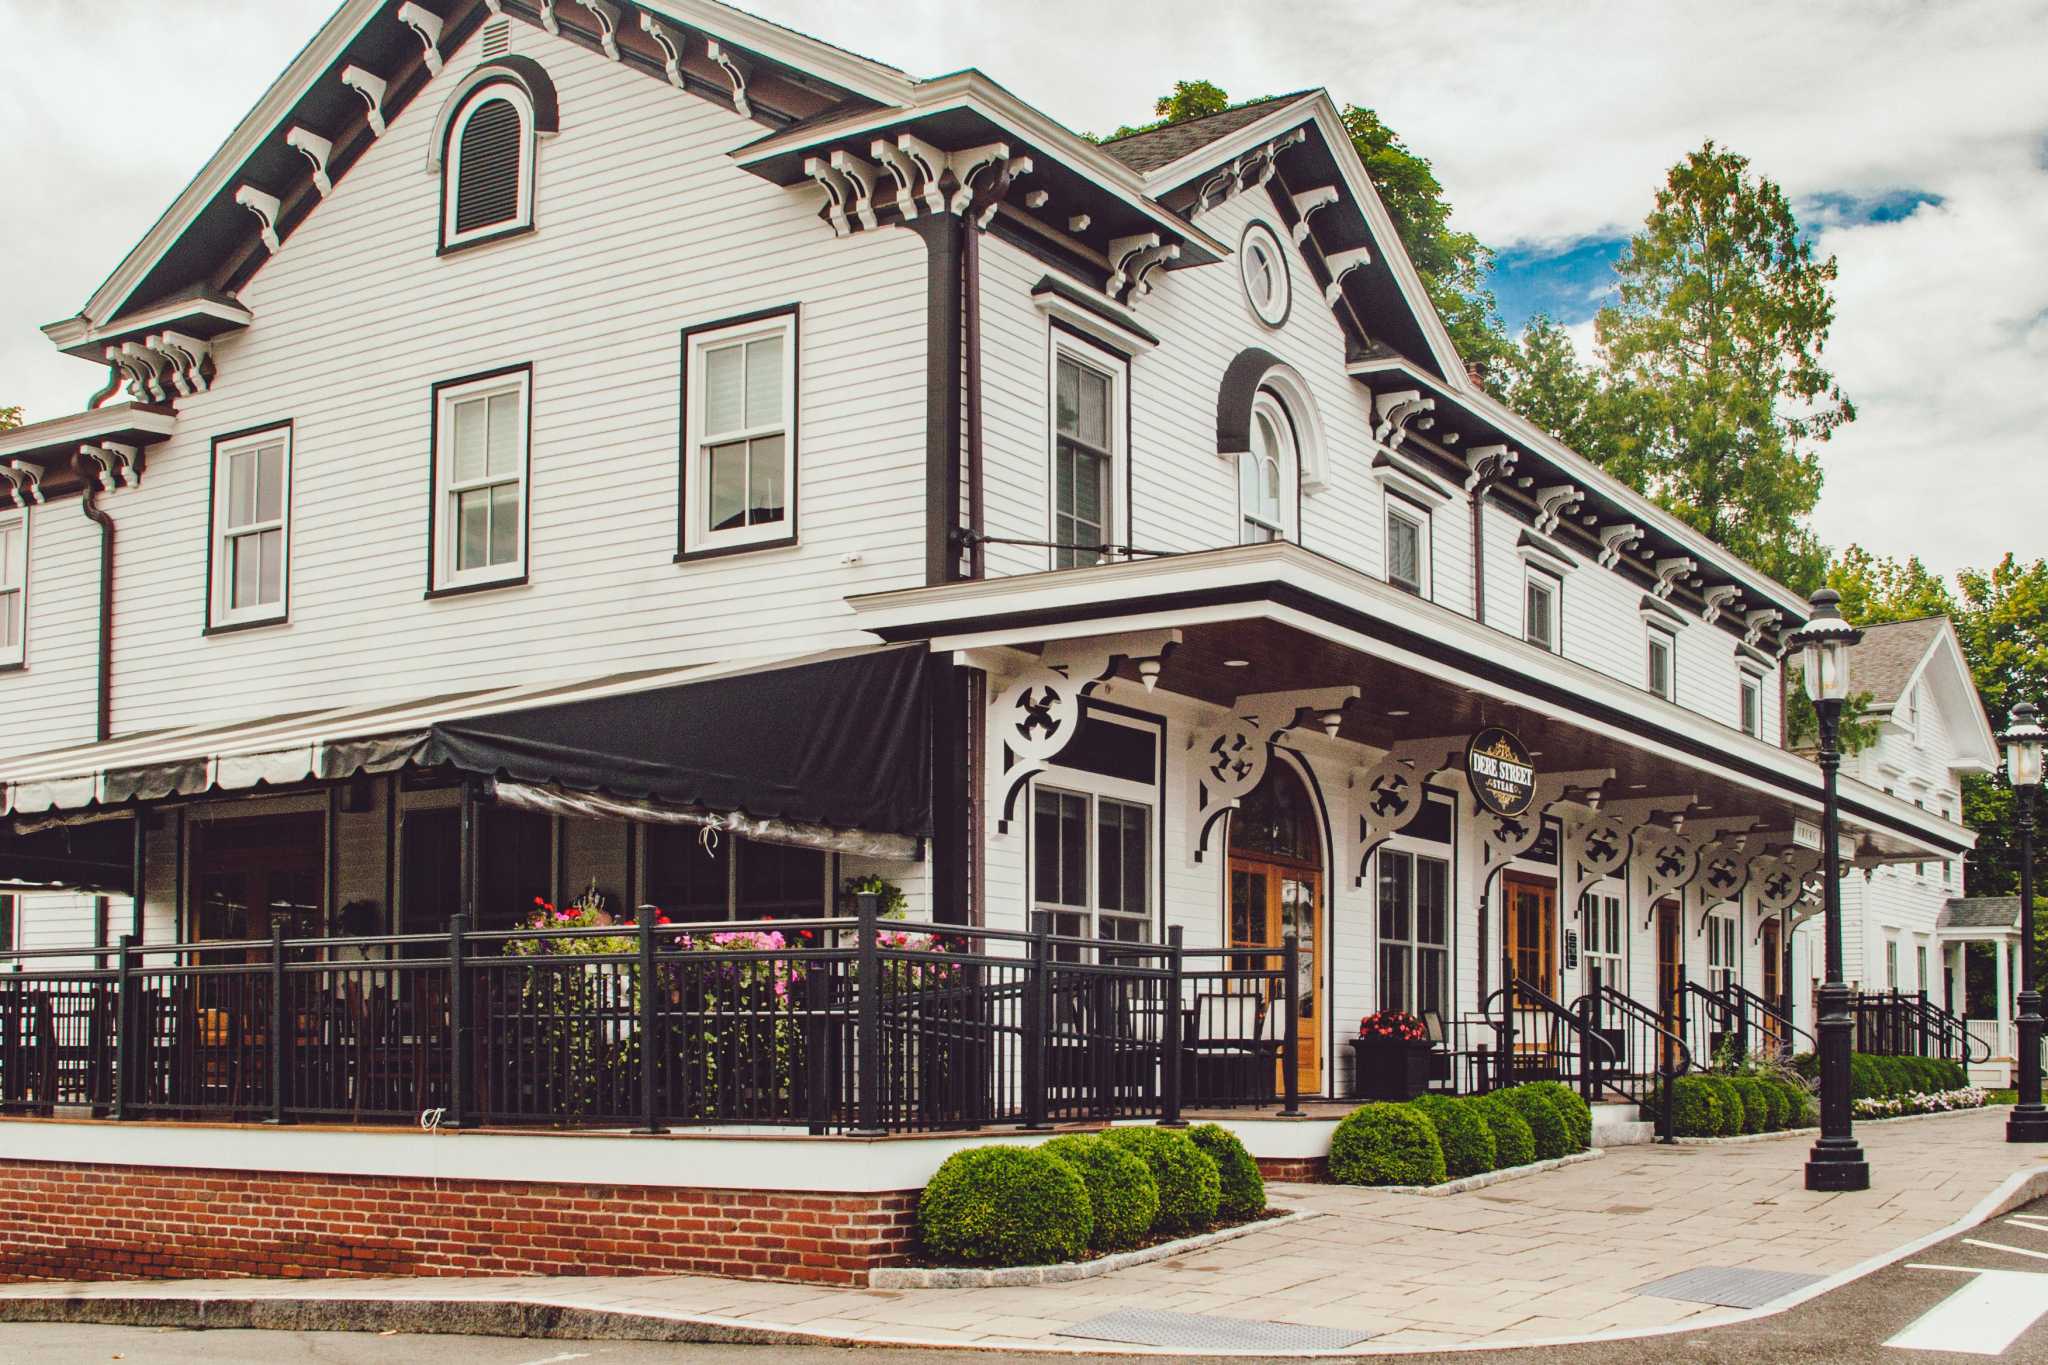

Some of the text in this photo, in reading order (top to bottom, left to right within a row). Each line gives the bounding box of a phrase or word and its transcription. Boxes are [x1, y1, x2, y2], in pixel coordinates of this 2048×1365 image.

[1472, 753, 1532, 786] DERE STREET
[1493, 779, 1514, 793] STEAK
